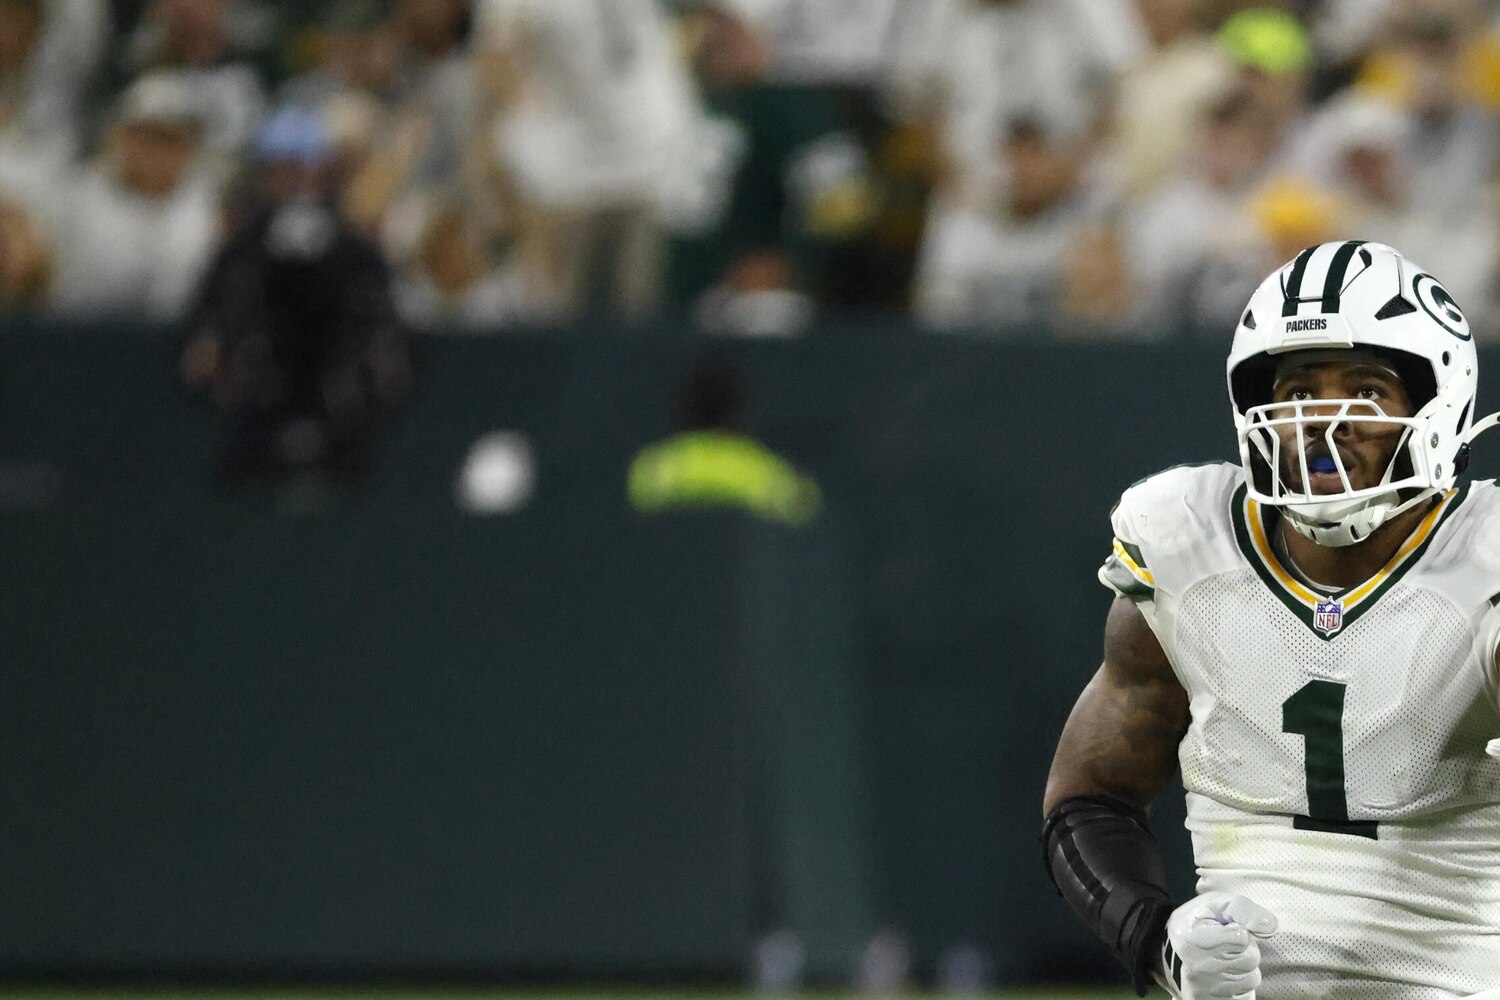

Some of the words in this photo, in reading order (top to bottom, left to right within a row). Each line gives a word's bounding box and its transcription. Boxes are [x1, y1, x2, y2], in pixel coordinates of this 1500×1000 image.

[1286, 318, 1327, 333] PACKERS
[1318, 614, 1338, 628] NFL
[1282, 679, 1379, 840] 1
